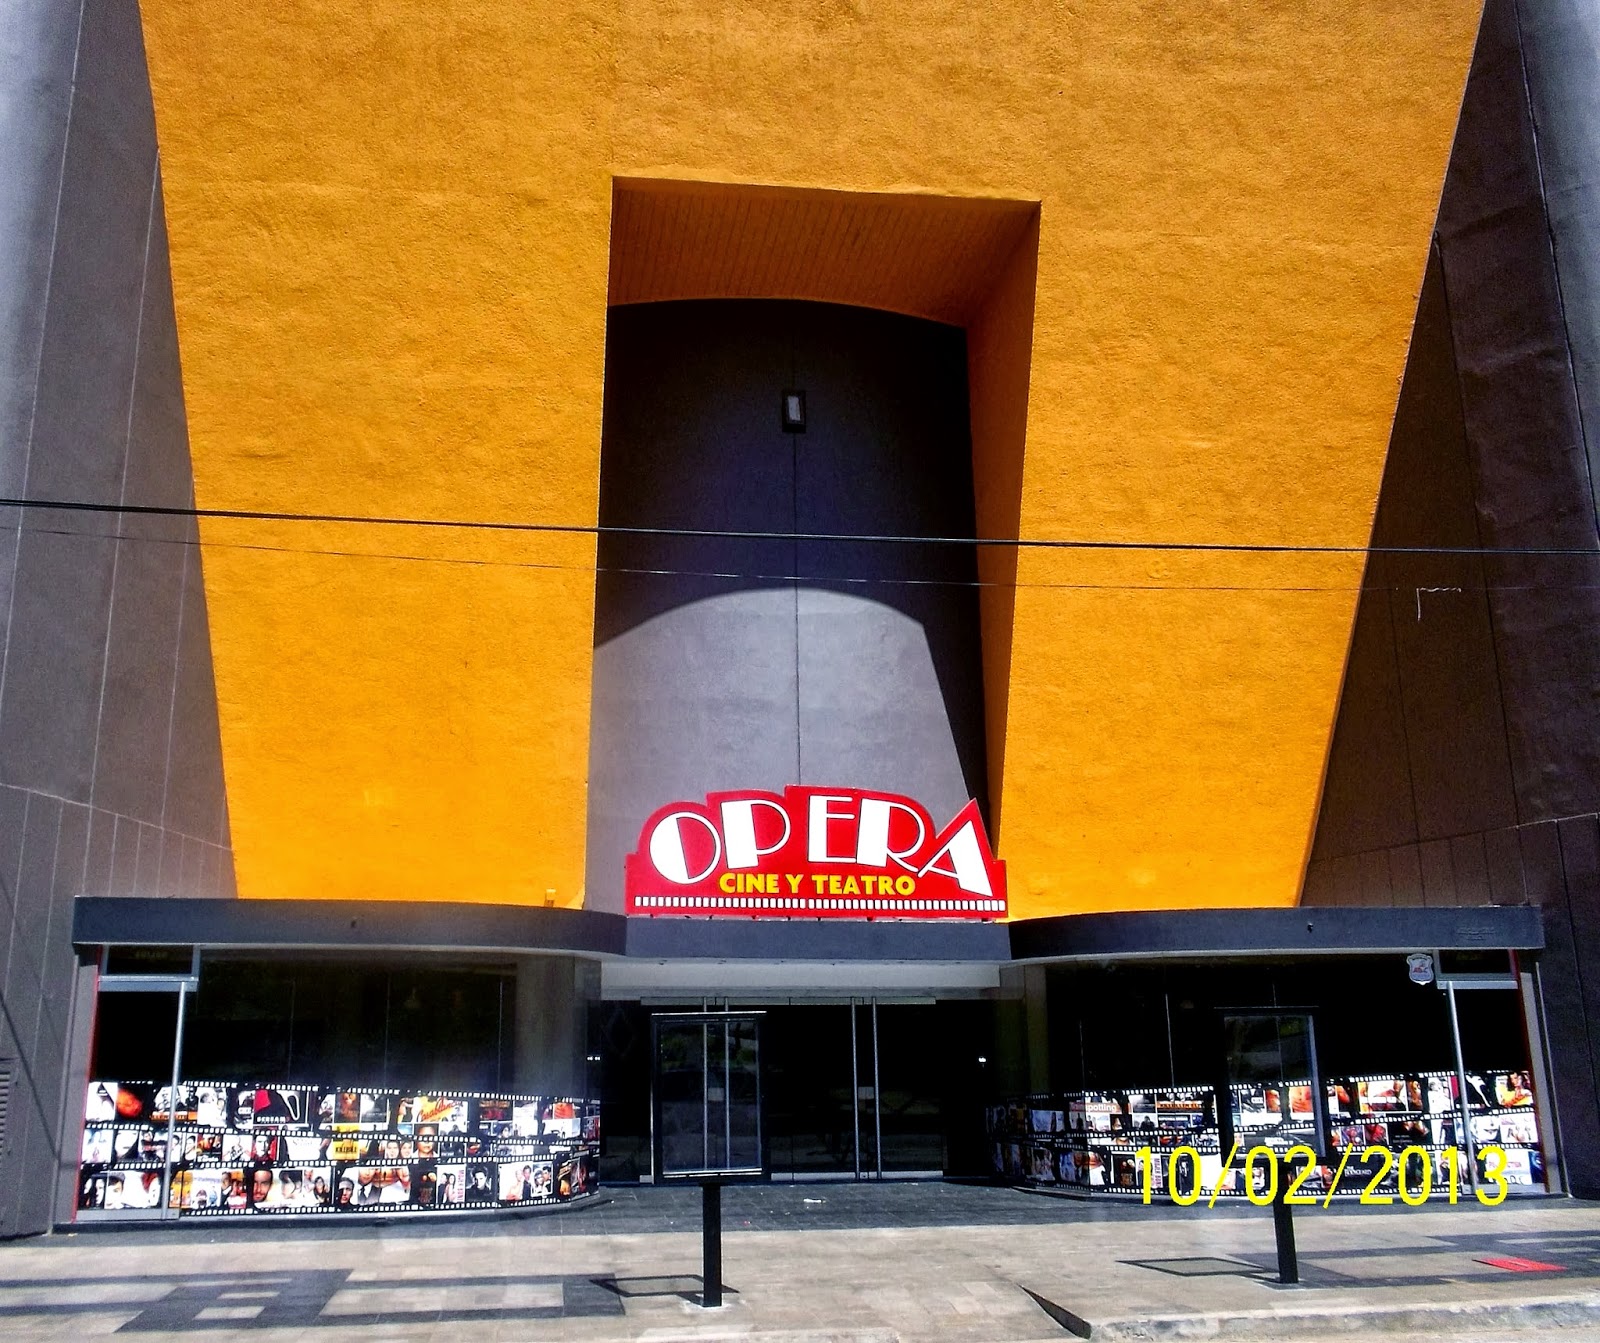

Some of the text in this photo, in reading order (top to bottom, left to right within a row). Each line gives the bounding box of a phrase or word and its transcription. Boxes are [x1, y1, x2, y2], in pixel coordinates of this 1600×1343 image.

[648, 795, 994, 898] OPERA
[719, 872, 916, 896] CINE Y TEATRO
